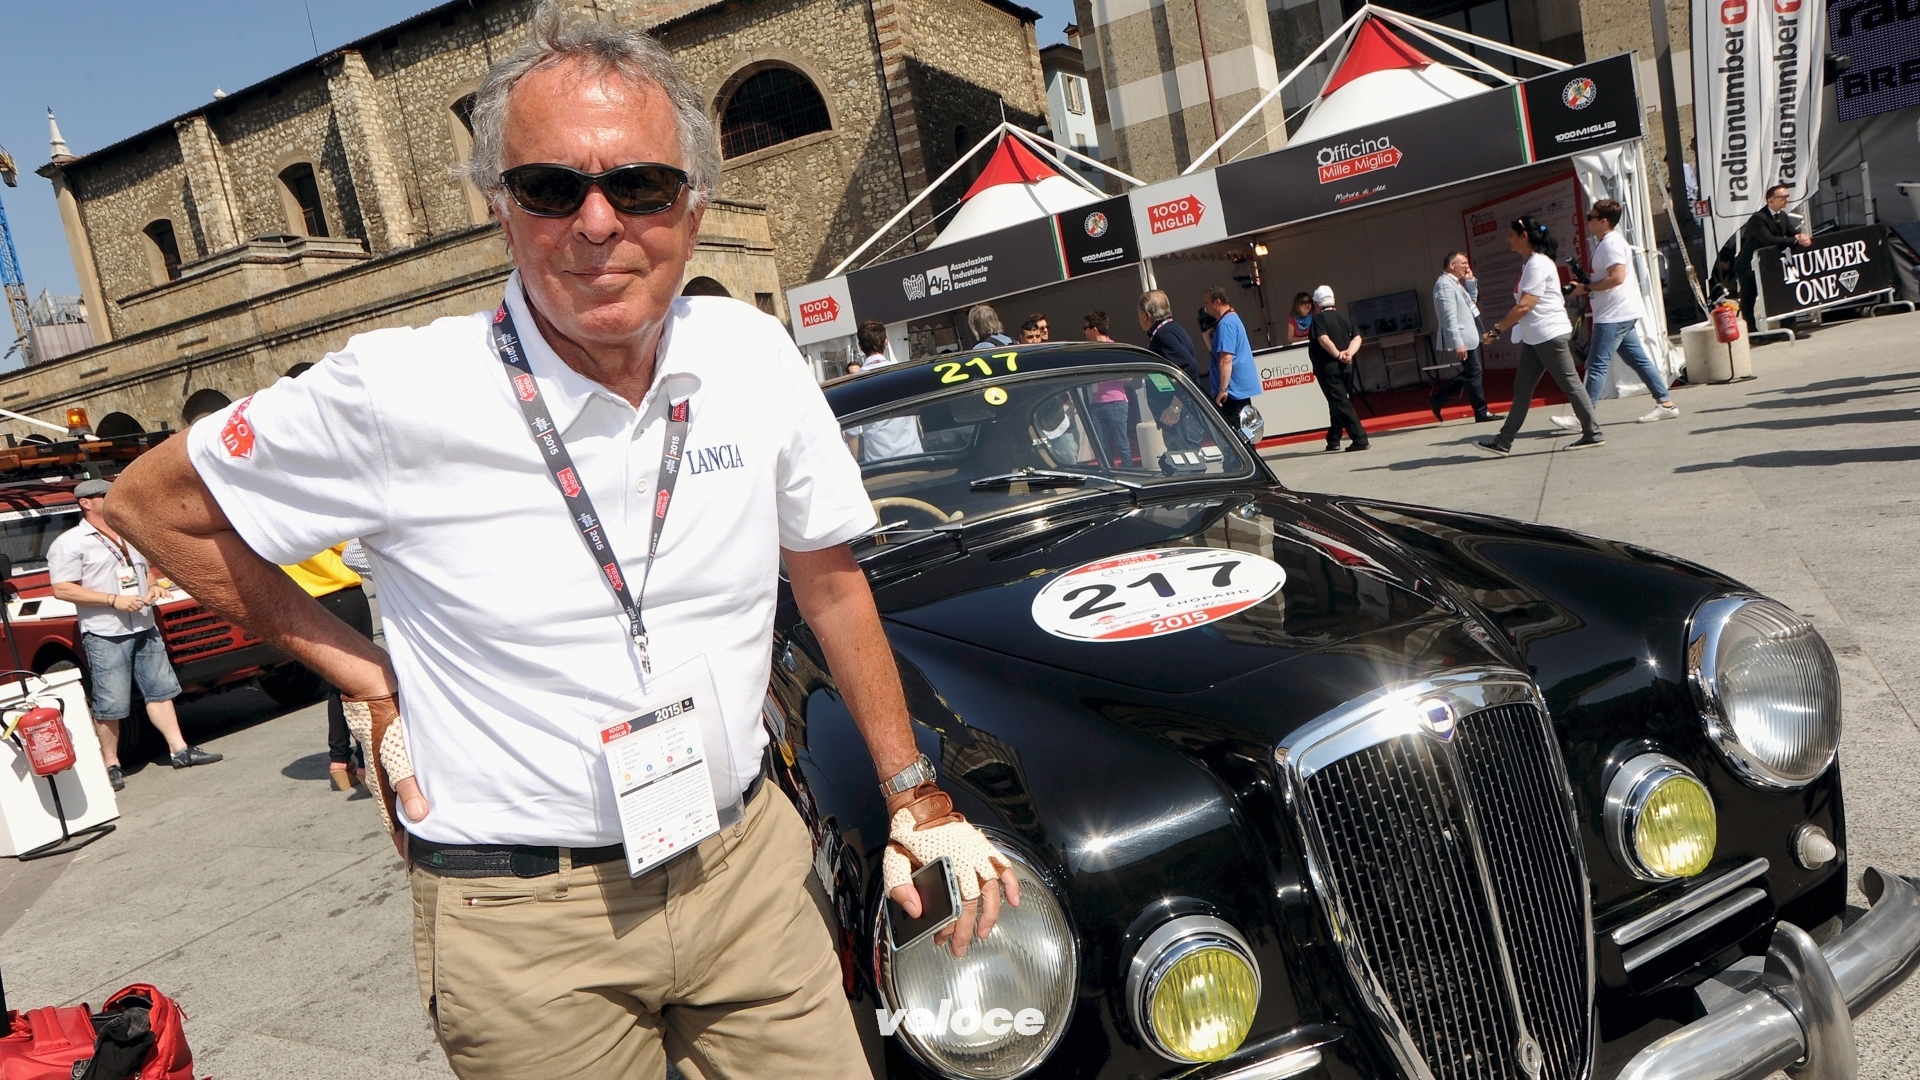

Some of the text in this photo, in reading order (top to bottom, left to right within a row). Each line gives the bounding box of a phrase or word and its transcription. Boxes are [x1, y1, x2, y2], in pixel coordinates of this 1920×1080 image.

[1316, 135, 1391, 166] Officina
[1322, 153, 1393, 180] Mille Miglia
[1334, 191, 1360, 202] Motore
[1153, 200, 1190, 218] 1000
[1153, 213, 1195, 233] MIGLIA
[950, 254, 994, 272] Associazione
[1780, 240, 1871, 285] NUMBER
[952, 265, 989, 281] Industriale
[953, 276, 988, 290] Bresciana
[1795, 273, 1840, 306] ONE
[803, 300, 829, 314] 1000
[804, 311, 834, 326] MIGLIA
[506, 345, 519, 363] 2015
[933, 351, 1019, 384] 217
[1260, 364, 1309, 380] Officina
[1264, 374, 1311, 390] Mille Miglia
[543, 434, 559, 456] 2015
[670, 435, 680, 456] 2015
[686, 443, 745, 476] LANCIA
[565, 471, 578, 490] 1000
[589, 530, 604, 551] 2015
[1062, 560, 1242, 620] 217
[1166, 589, 1250, 608] CHOPARD
[1150, 610, 1209, 634] 2015
[655, 703, 680, 722] 2015
